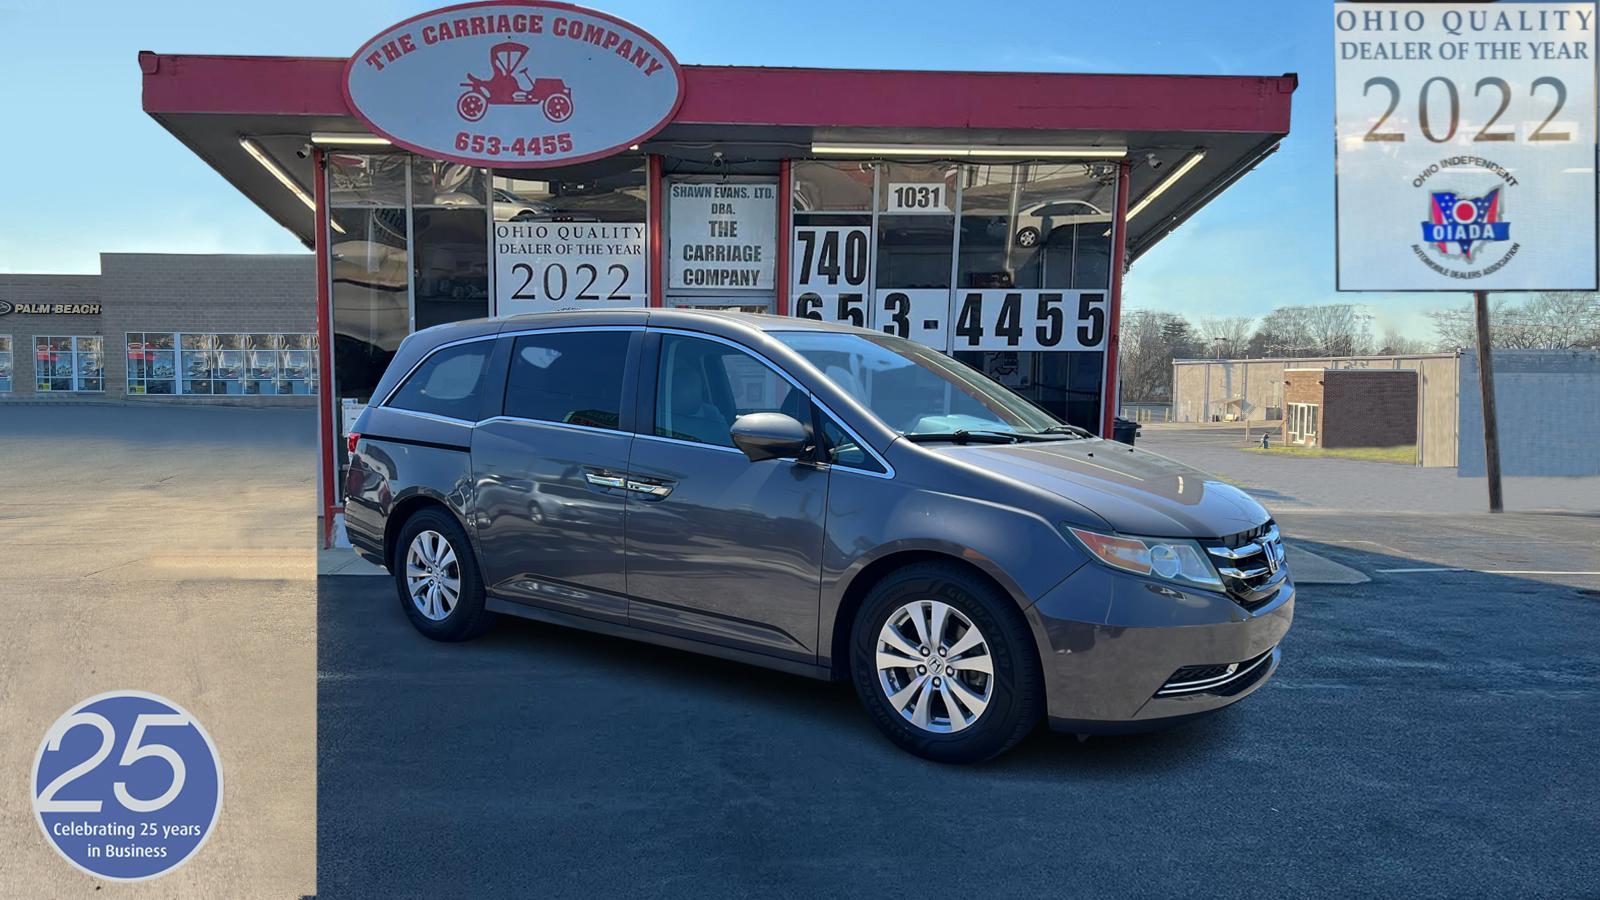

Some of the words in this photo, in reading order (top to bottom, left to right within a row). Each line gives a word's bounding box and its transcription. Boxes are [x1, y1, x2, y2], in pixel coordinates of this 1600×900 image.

[1336, 10, 1424, 31] OHIO
[1442, 10, 1592, 36] QUALITY
[366, 34, 416, 71] THE
[422, 14, 544, 45] CARRIAGE
[553, 17, 664, 77] COMPANY
[1341, 42, 1433, 60] DEALER
[1439, 42, 1469, 60] OF
[1475, 42, 1521, 60] THE
[1528, 42, 1589, 60] YEAR
[1362, 76, 1571, 143] 2022
[455, 131, 572, 156] 653-4455
[1412, 164, 1439, 188] OHIO
[1440, 156, 1519, 187] INDEPENDENT
[672, 186, 711, 199] SHAWN
[754, 187, 775, 199] LTD.
[894, 187, 940, 208] 1031
[711, 203, 736, 215] DBA.
[496, 226, 544, 239] OHIO
[557, 226, 643, 240] QUALITY
[708, 220, 738, 237] THE
[1432, 224, 1495, 240] OIADA
[500, 243, 551, 255] DEALER
[555, 243, 573, 255] OF
[576, 243, 603, 255] THE
[607, 243, 641, 255] YEAR
[683, 244, 762, 262] CARRIAGE
[797, 230, 868, 286] 740
[511, 263, 632, 300] 2022
[683, 268, 760, 286] COMPANY
[1449, 270, 1481, 279] DEALERS
[15, 304, 50, 314] PALM
[54, 304, 100, 314] BEACH
